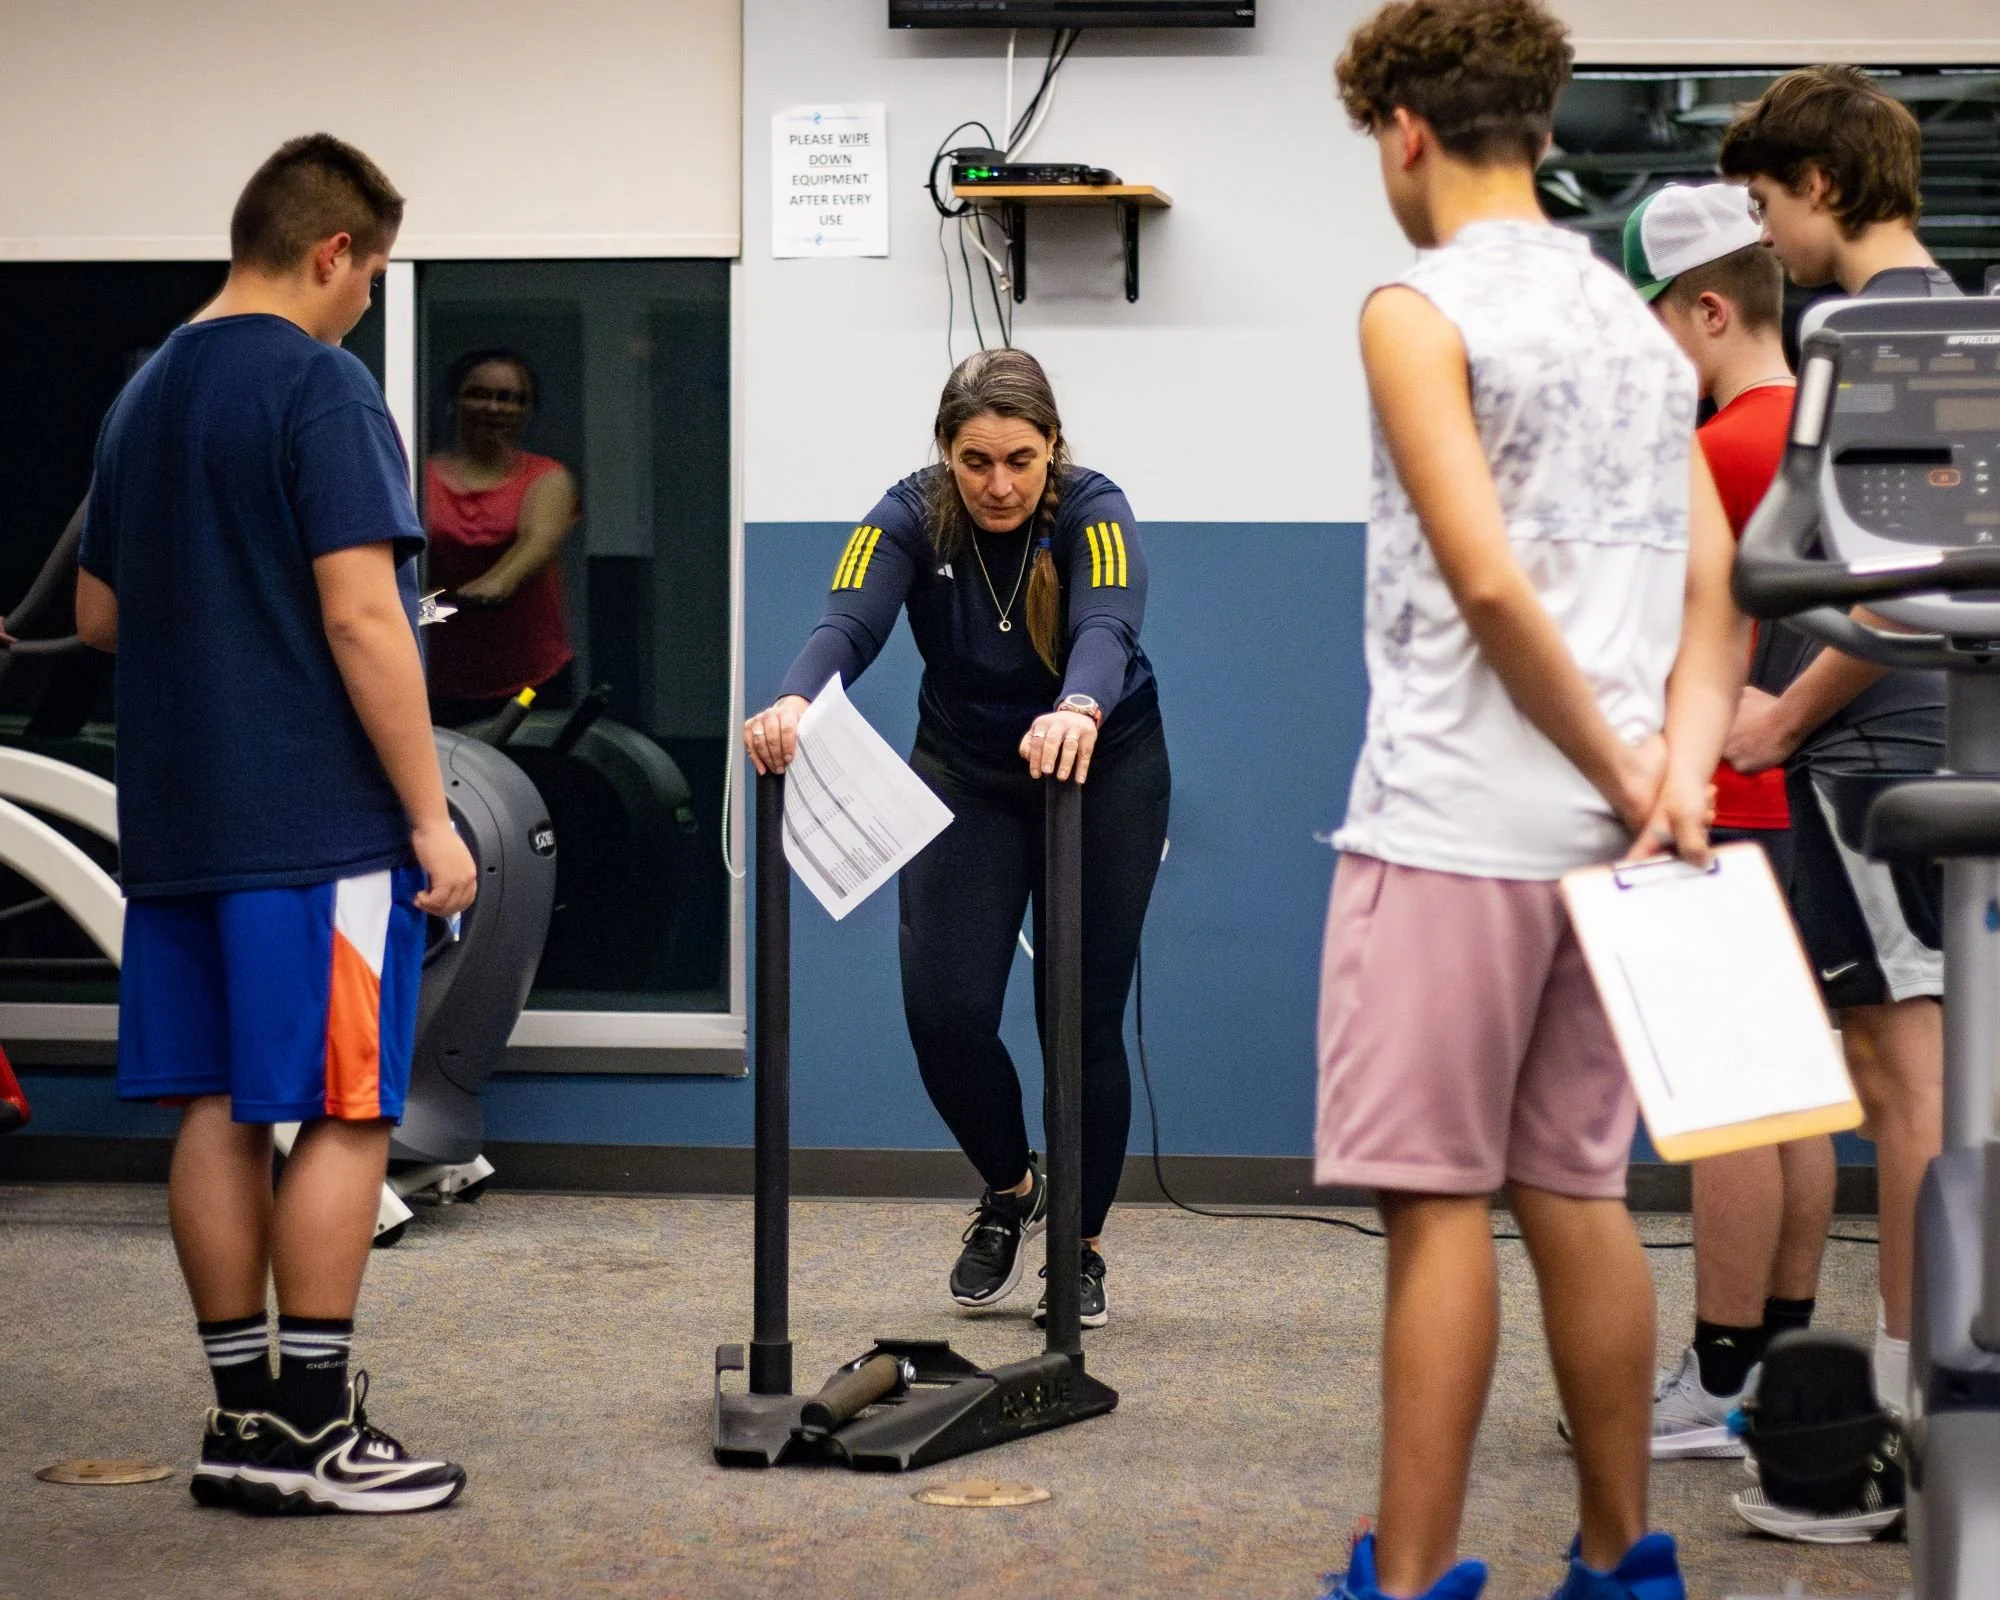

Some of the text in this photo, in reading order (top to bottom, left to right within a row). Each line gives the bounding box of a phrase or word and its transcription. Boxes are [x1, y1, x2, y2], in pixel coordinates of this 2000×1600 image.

[789, 133, 871, 145] PLEASE WIPE
[808, 154, 852, 166] DOWN
[791, 173, 869, 186] EQUIPMENT
[789, 193, 872, 206] AFTER EVERY
[819, 214, 843, 226] USE
